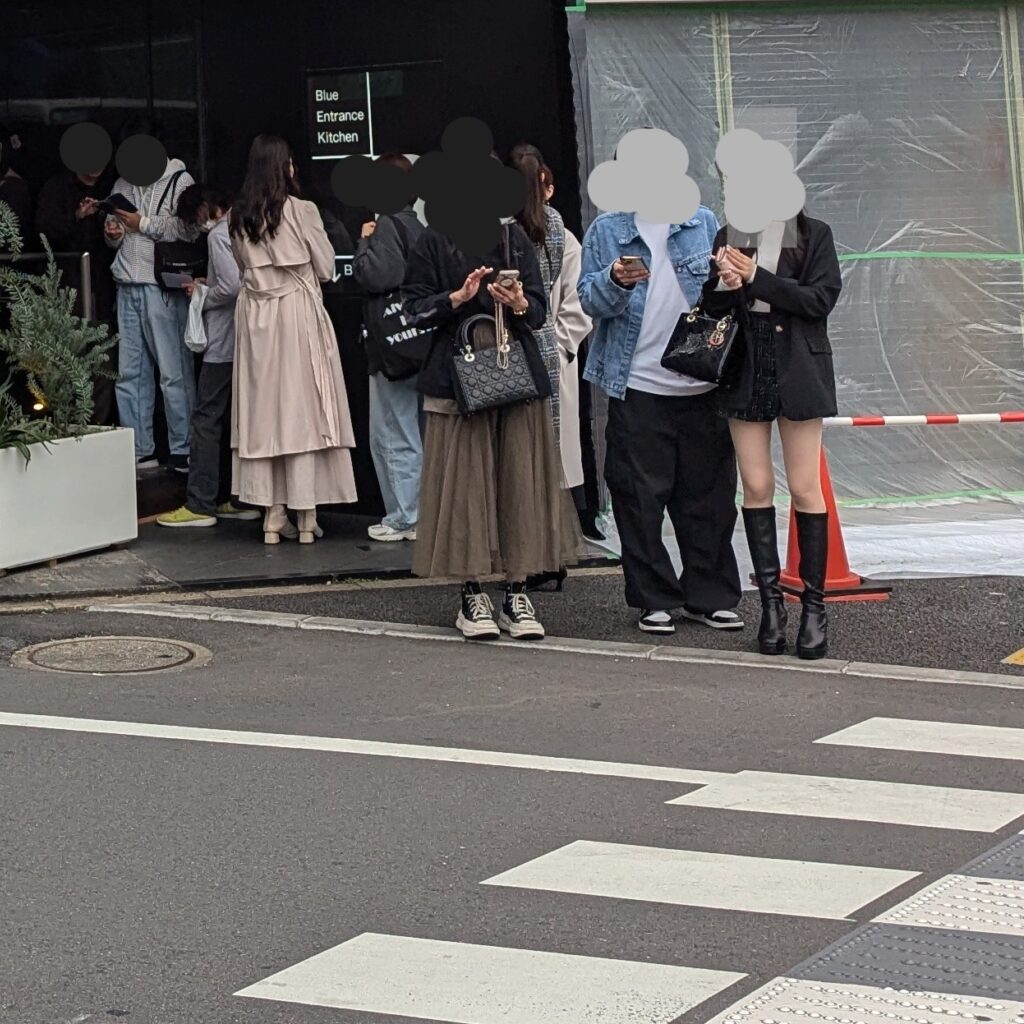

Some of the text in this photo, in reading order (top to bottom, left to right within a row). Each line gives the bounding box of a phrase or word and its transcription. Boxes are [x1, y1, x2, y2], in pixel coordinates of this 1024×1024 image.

[315, 89, 339, 102] Blue
[316, 110, 365, 123] Entrance
[317, 131, 359, 144] Kitchen
